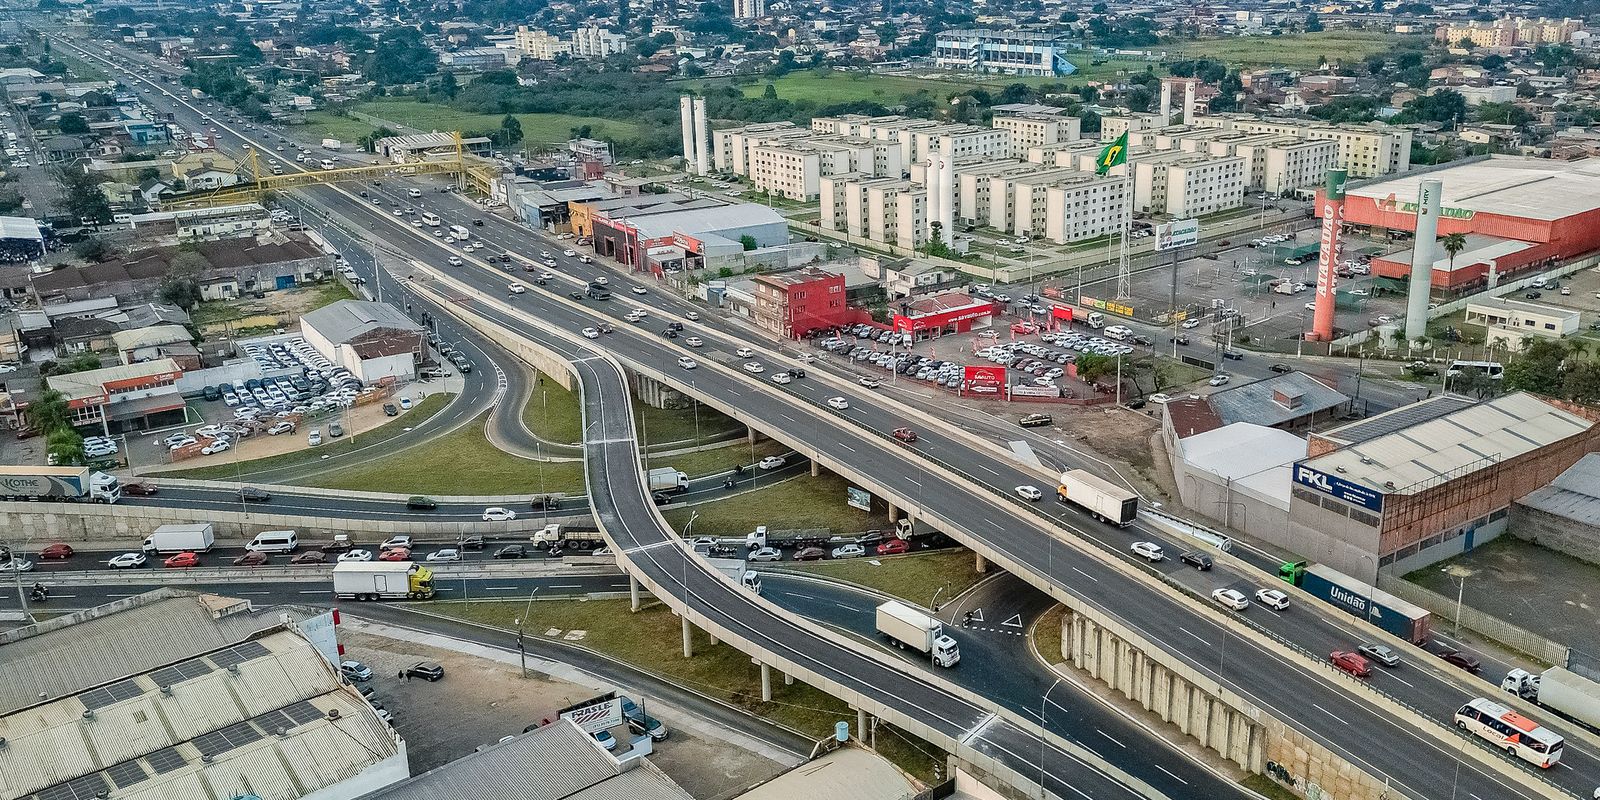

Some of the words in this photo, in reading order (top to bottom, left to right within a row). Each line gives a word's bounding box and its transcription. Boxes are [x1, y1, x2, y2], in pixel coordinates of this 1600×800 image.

[1298, 466, 1333, 491] FKL
[1330, 585, 1366, 611] Unidão
[1482, 726, 1505, 741] Local
